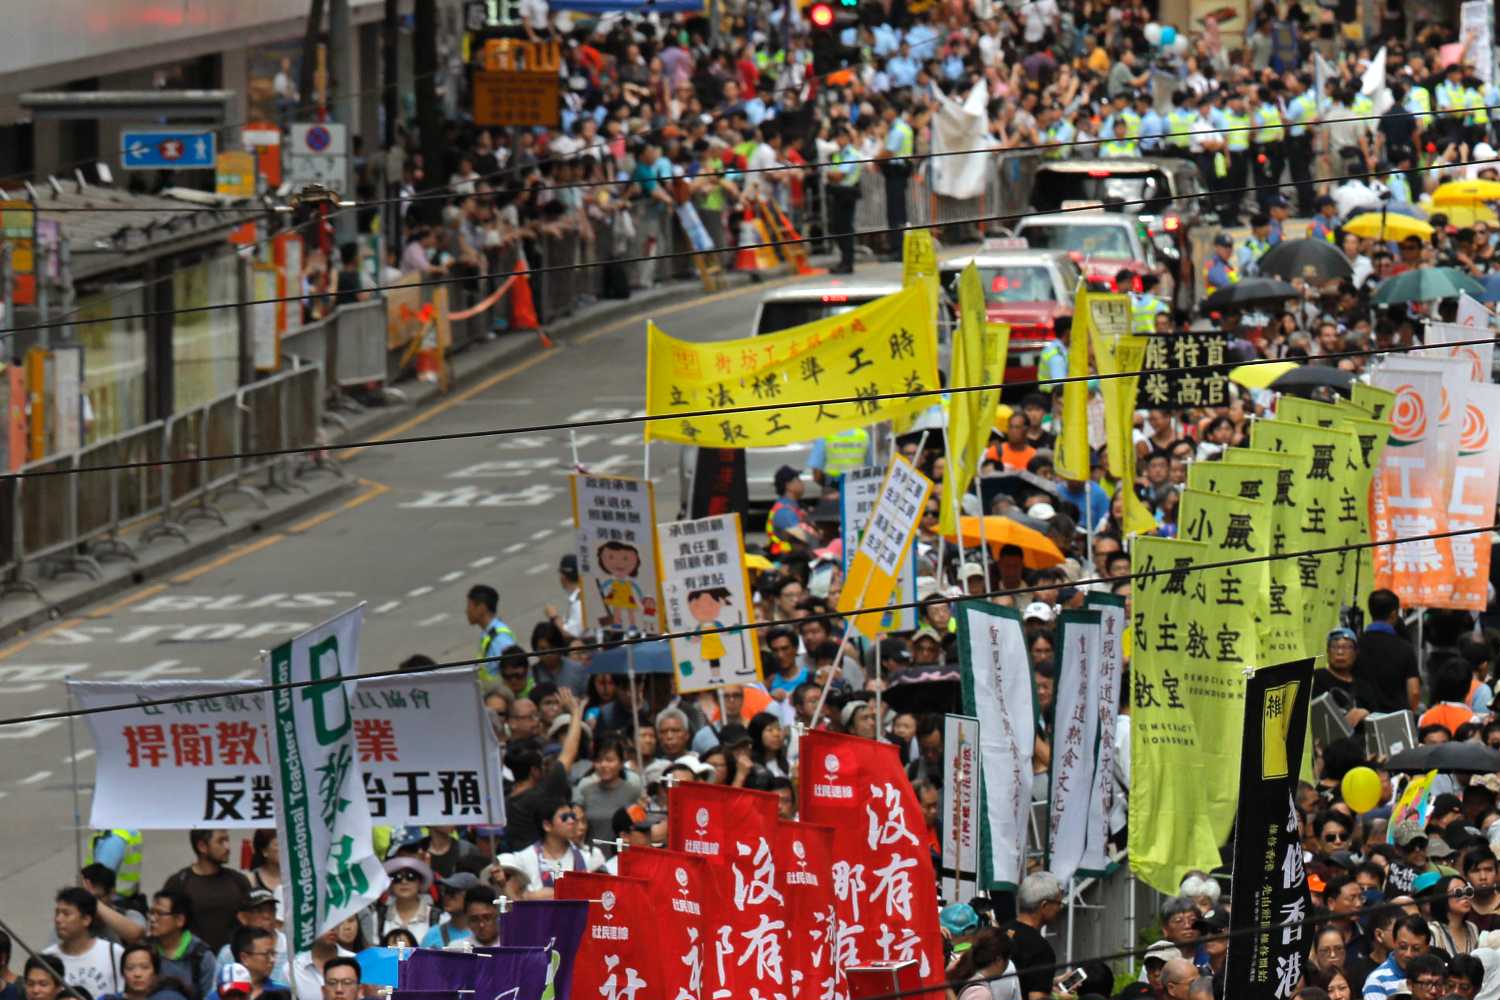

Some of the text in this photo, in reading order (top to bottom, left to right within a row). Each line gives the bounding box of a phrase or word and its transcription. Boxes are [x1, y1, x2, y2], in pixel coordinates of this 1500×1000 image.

[1137, 373, 1228, 407] 柴高官
[276, 659, 291, 713] Union
[123, 718, 400, 768] 捍衛教業
[203, 769, 482, 822] 反對治干預
[288, 808, 316, 916] Professional
[301, 916, 314, 948] HK
